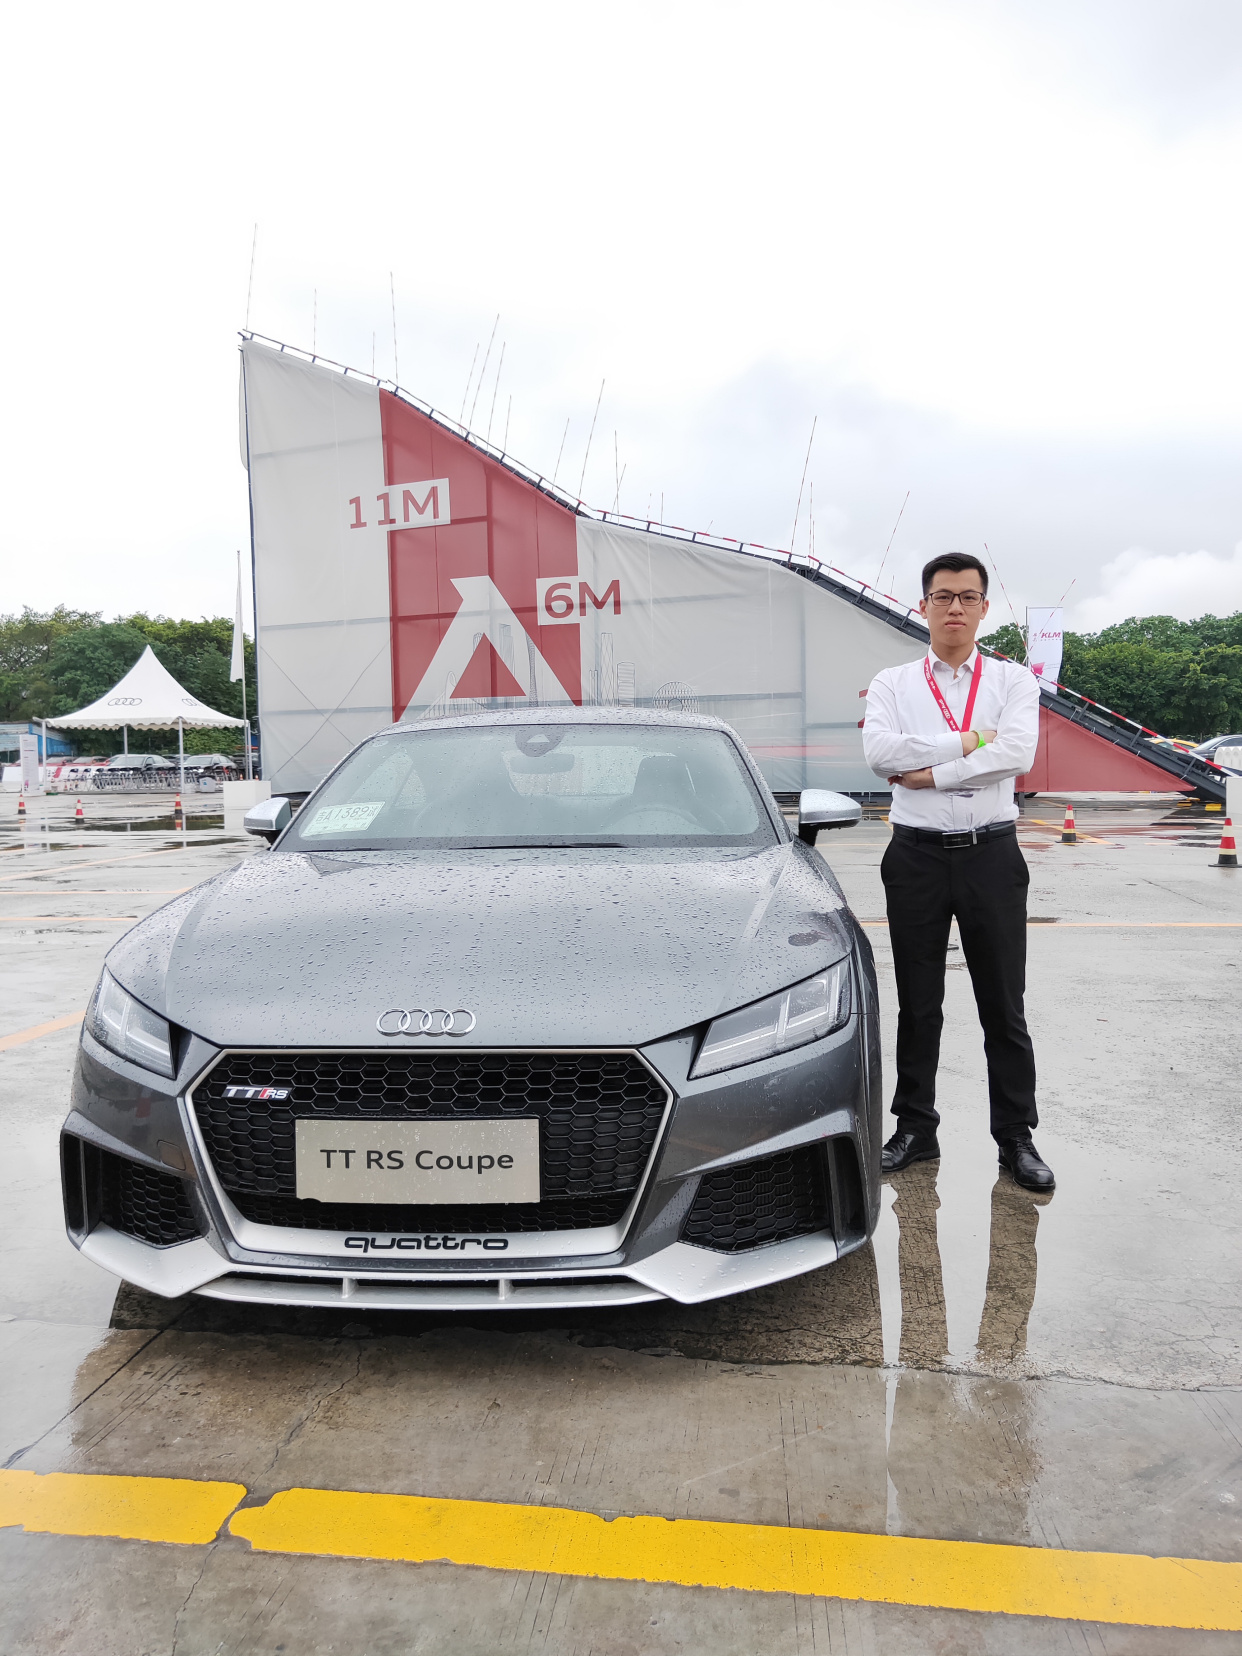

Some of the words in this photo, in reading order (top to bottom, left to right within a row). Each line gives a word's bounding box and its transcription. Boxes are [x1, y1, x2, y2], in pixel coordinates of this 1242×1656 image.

[349, 486, 440, 529] 11M
[544, 579, 622, 619] 6M
[319, 1149, 356, 1169] TT
[366, 1150, 405, 1170] RS
[414, 1150, 515, 1175] Coupe
[344, 1234, 509, 1253] quattro
